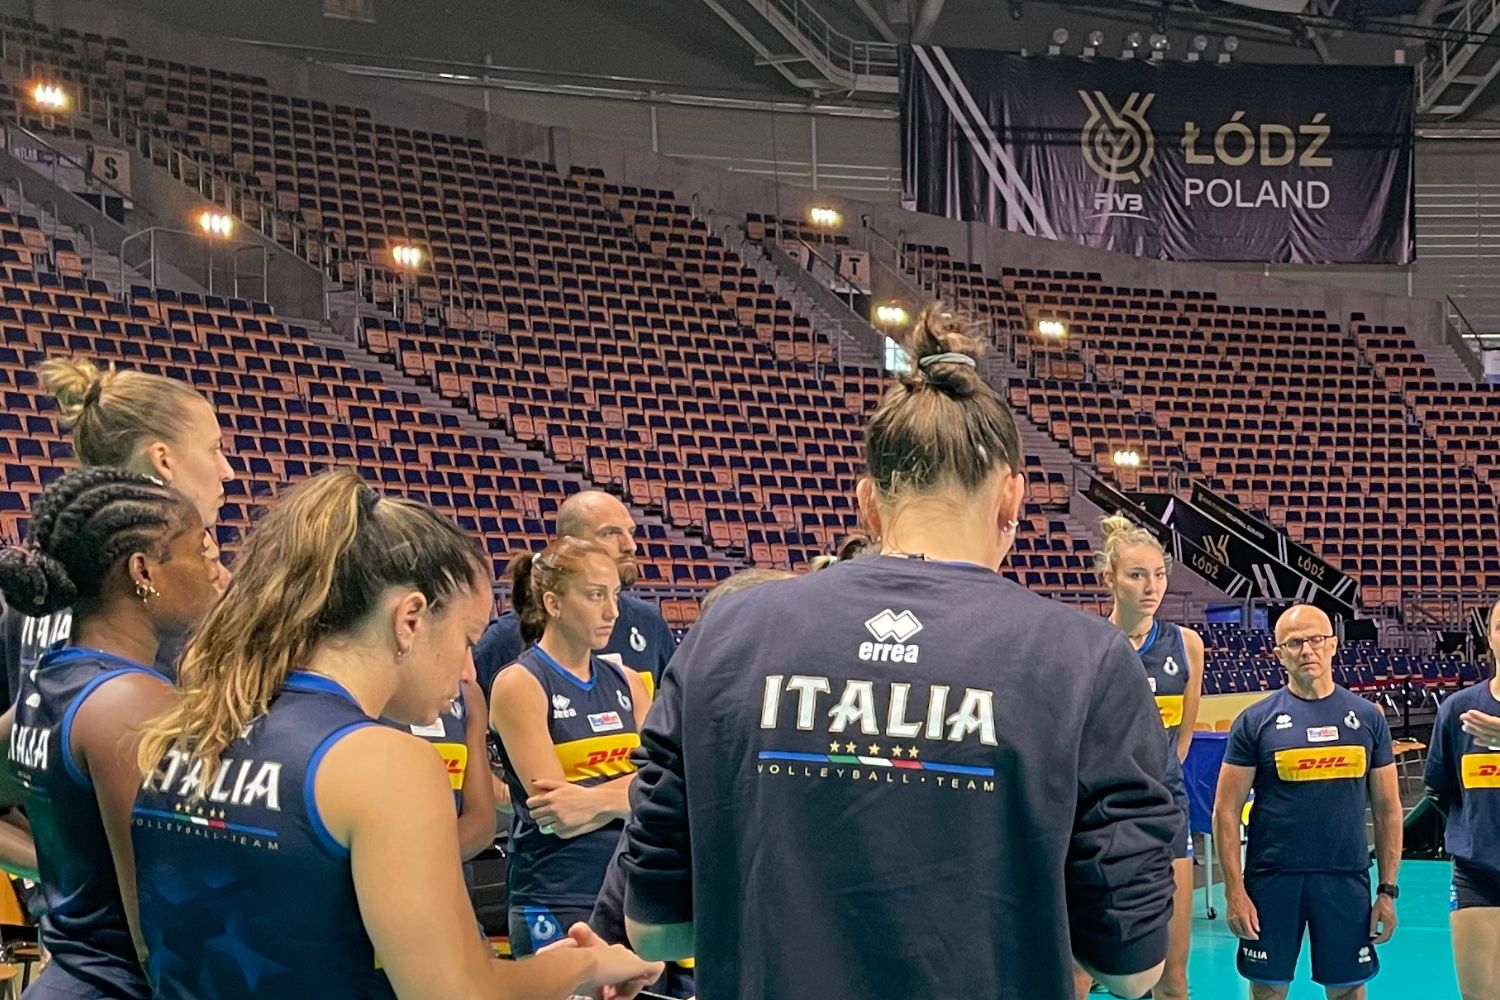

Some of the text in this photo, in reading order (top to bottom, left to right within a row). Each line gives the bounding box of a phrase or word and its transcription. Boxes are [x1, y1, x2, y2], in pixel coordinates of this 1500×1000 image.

[1181, 111, 1333, 168] ŁÓDŹ
[103, 157, 119, 180] S
[1184, 178, 1331, 210] POLAND
[848, 257, 861, 275] T
[1298, 555, 1326, 581] ŁÓDŹ
[858, 641, 920, 664] errea
[760, 675, 998, 746] ITALIA
[1297, 757, 1350, 771] DHL
[757, 764, 995, 792] VOLLEYBALL TEAM
[132, 817, 279, 851] OLLEYBALL TEAM
